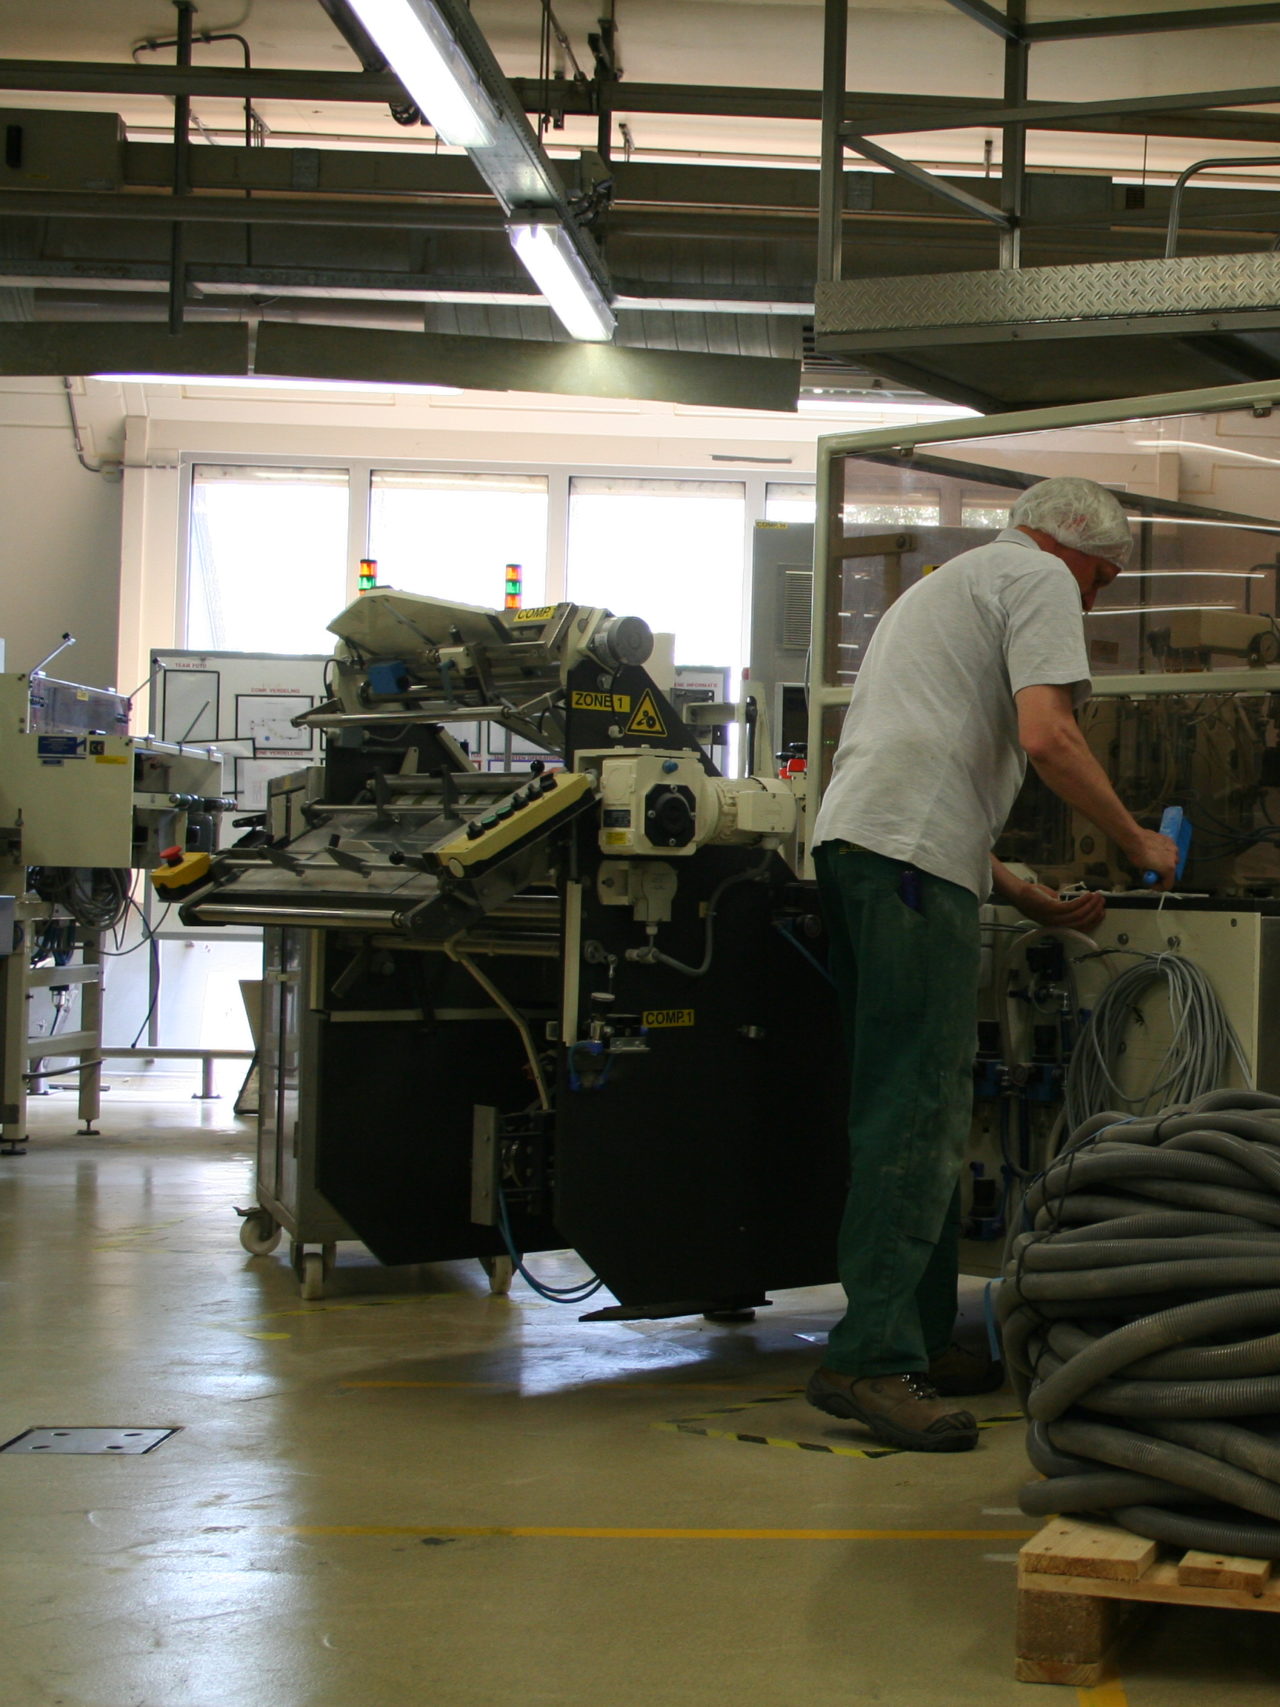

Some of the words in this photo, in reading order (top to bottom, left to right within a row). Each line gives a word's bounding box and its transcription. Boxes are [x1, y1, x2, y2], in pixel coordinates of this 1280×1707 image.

[575, 693, 612, 708] ZONE
[617, 697, 623, 709] 1
[646, 1011, 692, 1025] COMP.1
